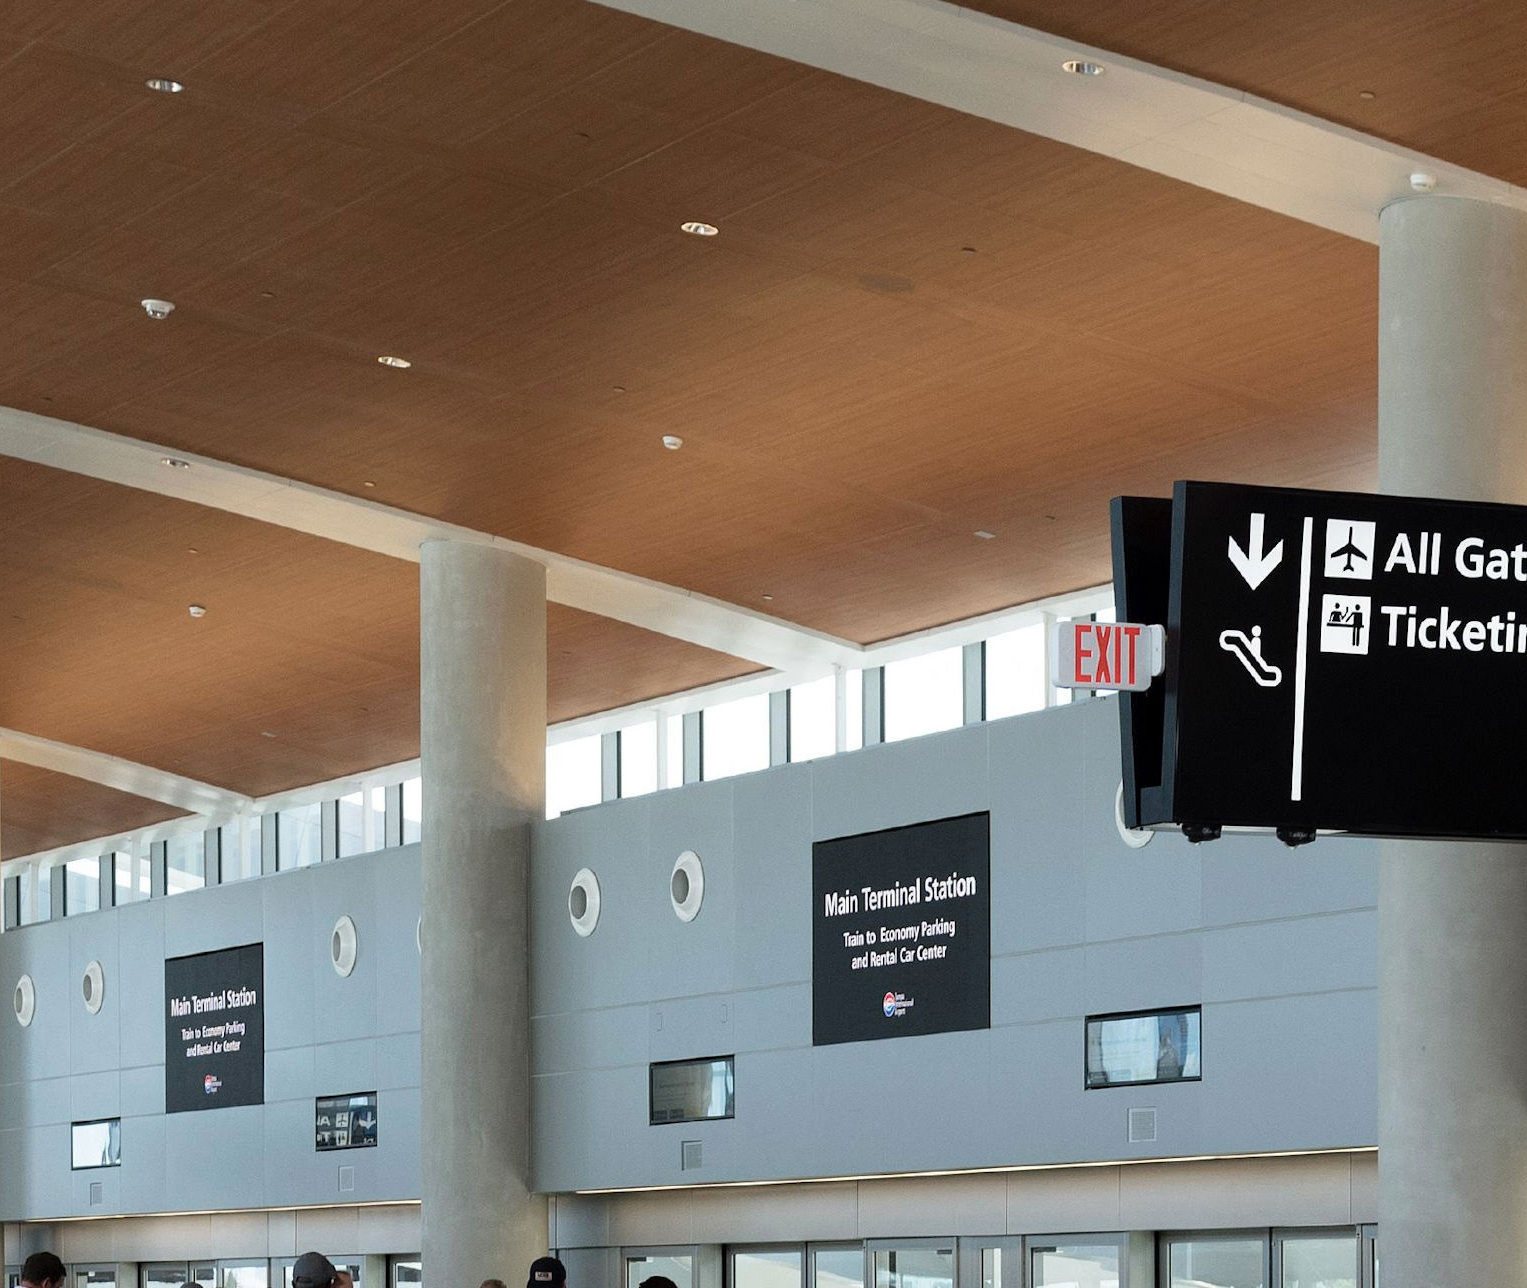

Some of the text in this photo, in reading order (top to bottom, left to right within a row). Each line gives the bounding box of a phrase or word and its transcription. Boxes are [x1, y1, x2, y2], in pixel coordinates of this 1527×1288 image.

[1383, 531, 1442, 576] All
[1073, 624, 1142, 686] EXIT
[824, 872, 977, 917] Main Terminal Station
[843, 918, 956, 947] Train to Economy Parking
[851, 944, 947, 970] and Rental Car Center
[171, 986, 256, 1017] Main Terminal Station
[181, 1021, 246, 1040] Train to Economy Parking
[186, 1040, 241, 1057] and Rental Car Center
